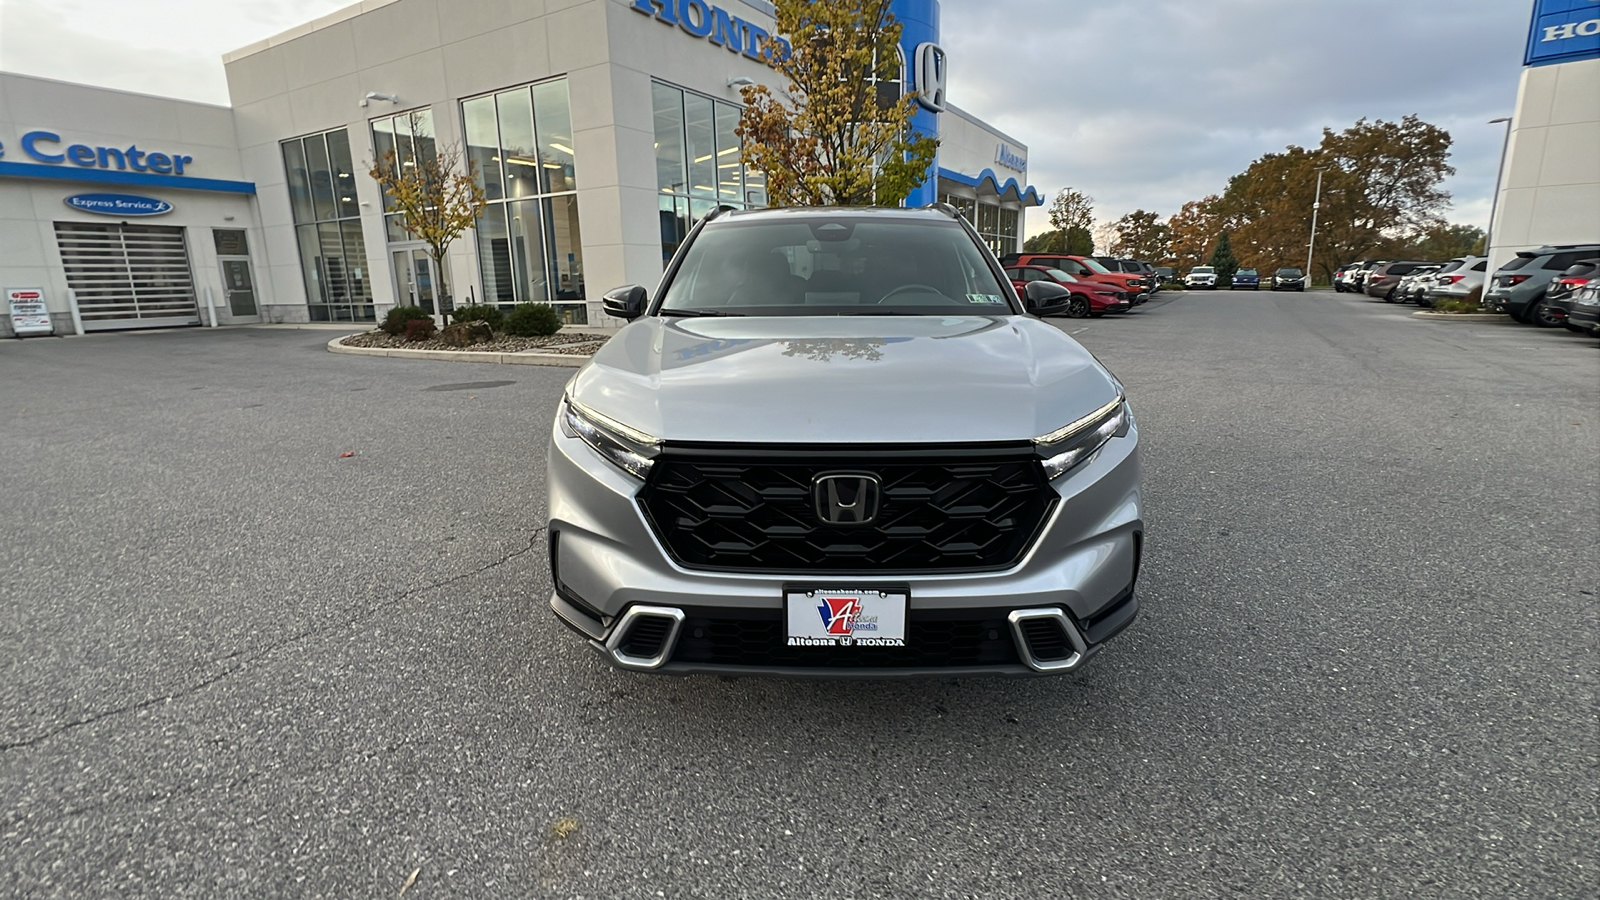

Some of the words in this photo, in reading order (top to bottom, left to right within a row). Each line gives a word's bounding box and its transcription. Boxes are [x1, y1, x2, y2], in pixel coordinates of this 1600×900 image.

[1541, 19, 1600, 42] HO
[21, 131, 193, 175] Center
[73, 198, 114, 208] Express
[115, 200, 152, 209] Service
[847, 621, 877, 631] Honda
[787, 637, 836, 646] Altoona
[856, 638, 905, 646] HONDA
